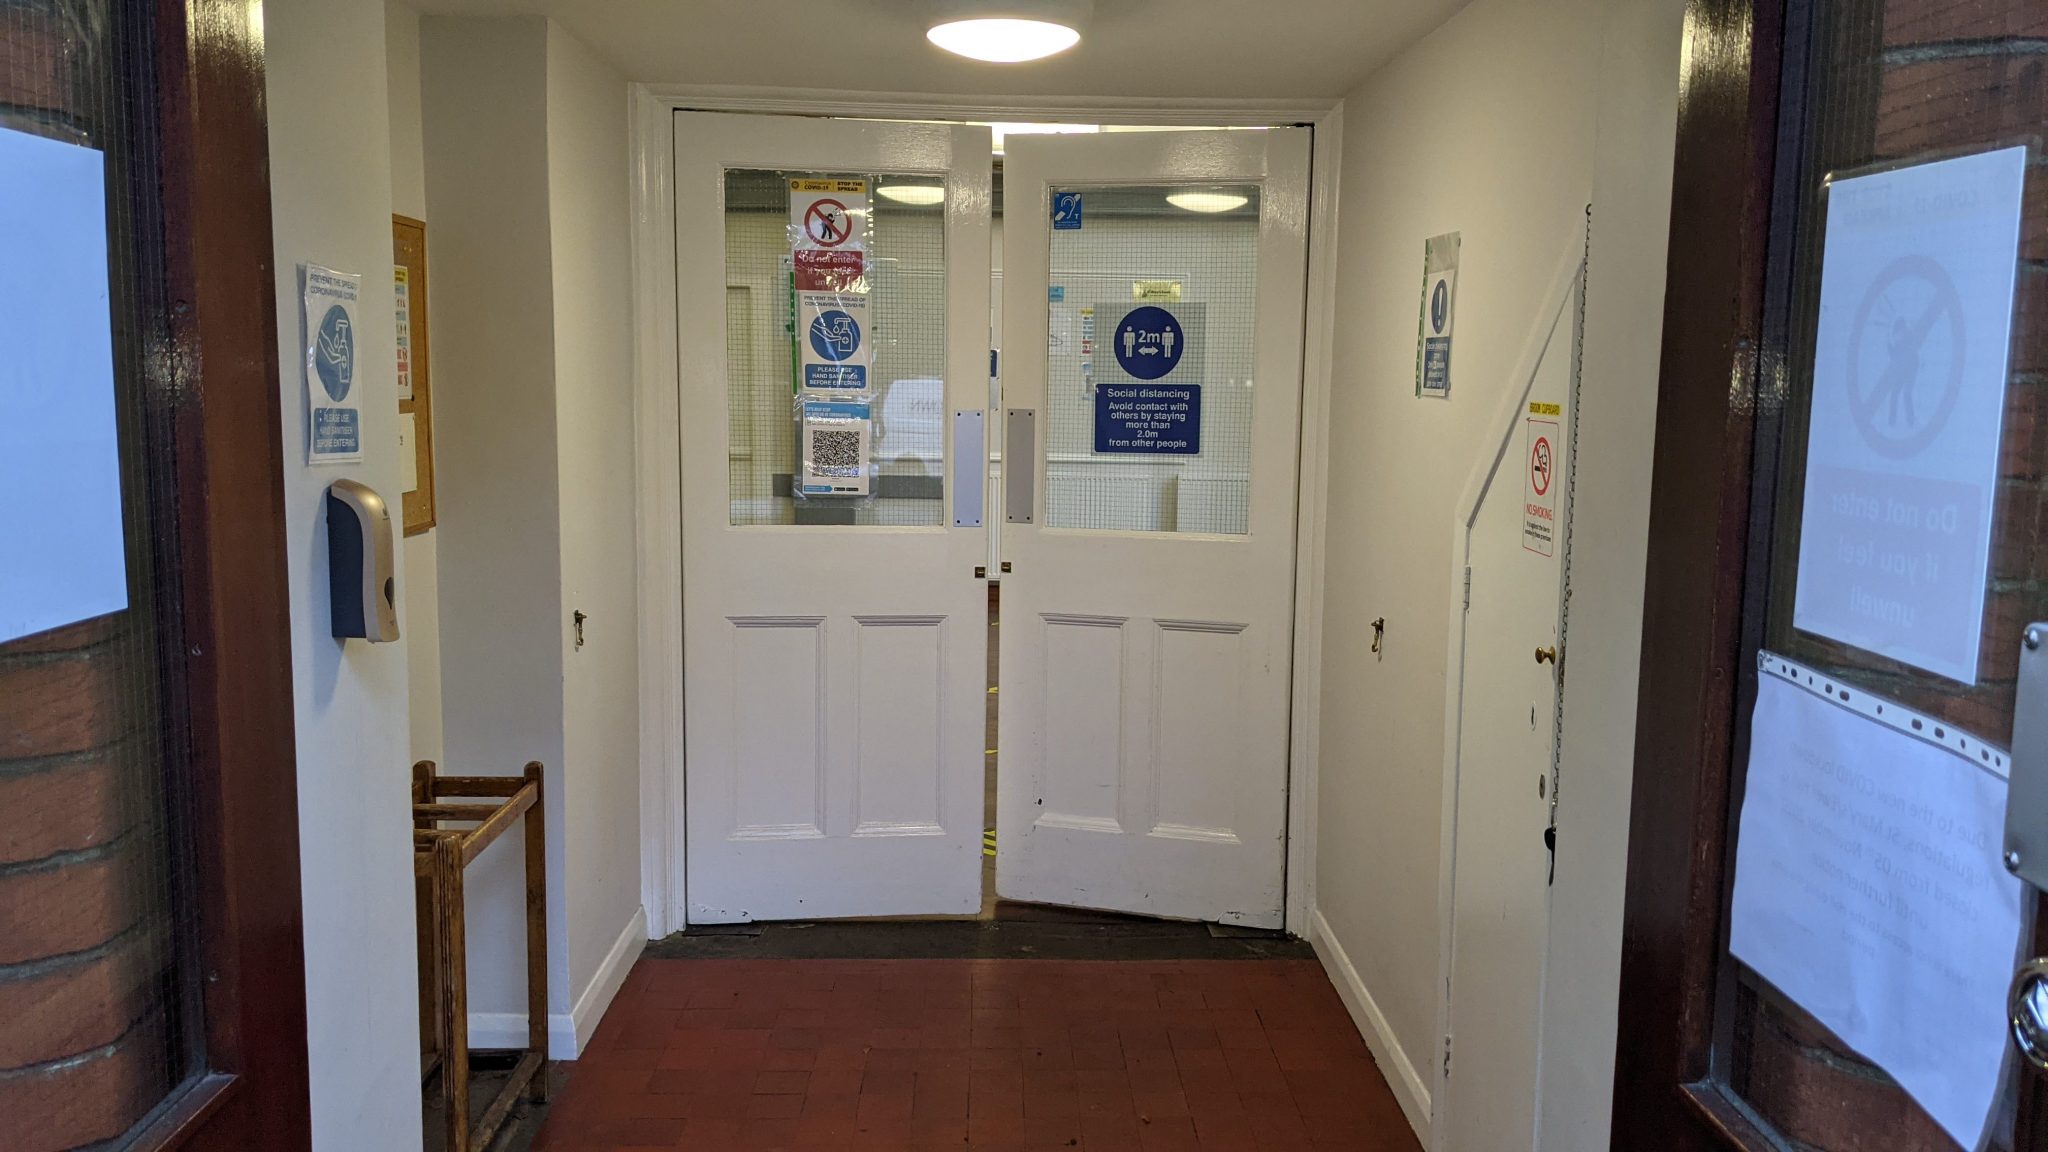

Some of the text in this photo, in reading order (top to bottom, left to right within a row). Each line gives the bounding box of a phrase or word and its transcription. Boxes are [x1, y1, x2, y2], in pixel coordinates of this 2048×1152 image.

[802, 254, 856, 264] Do not enter
[814, 268, 831, 276] you
[815, 279, 843, 287] unell
[1138, 330, 1160, 343] 2m
[1107, 388, 1190, 400] Social distancing
[1108, 402, 1188, 411] Avoid contact with
[1111, 411, 1186, 421] others by staying
[1126, 421, 1171, 429] more than
[1137, 429, 1159, 438] 2.0m
[1108, 438, 1187, 449] from other people
[1532, 504, 1553, 521] SMOKING
